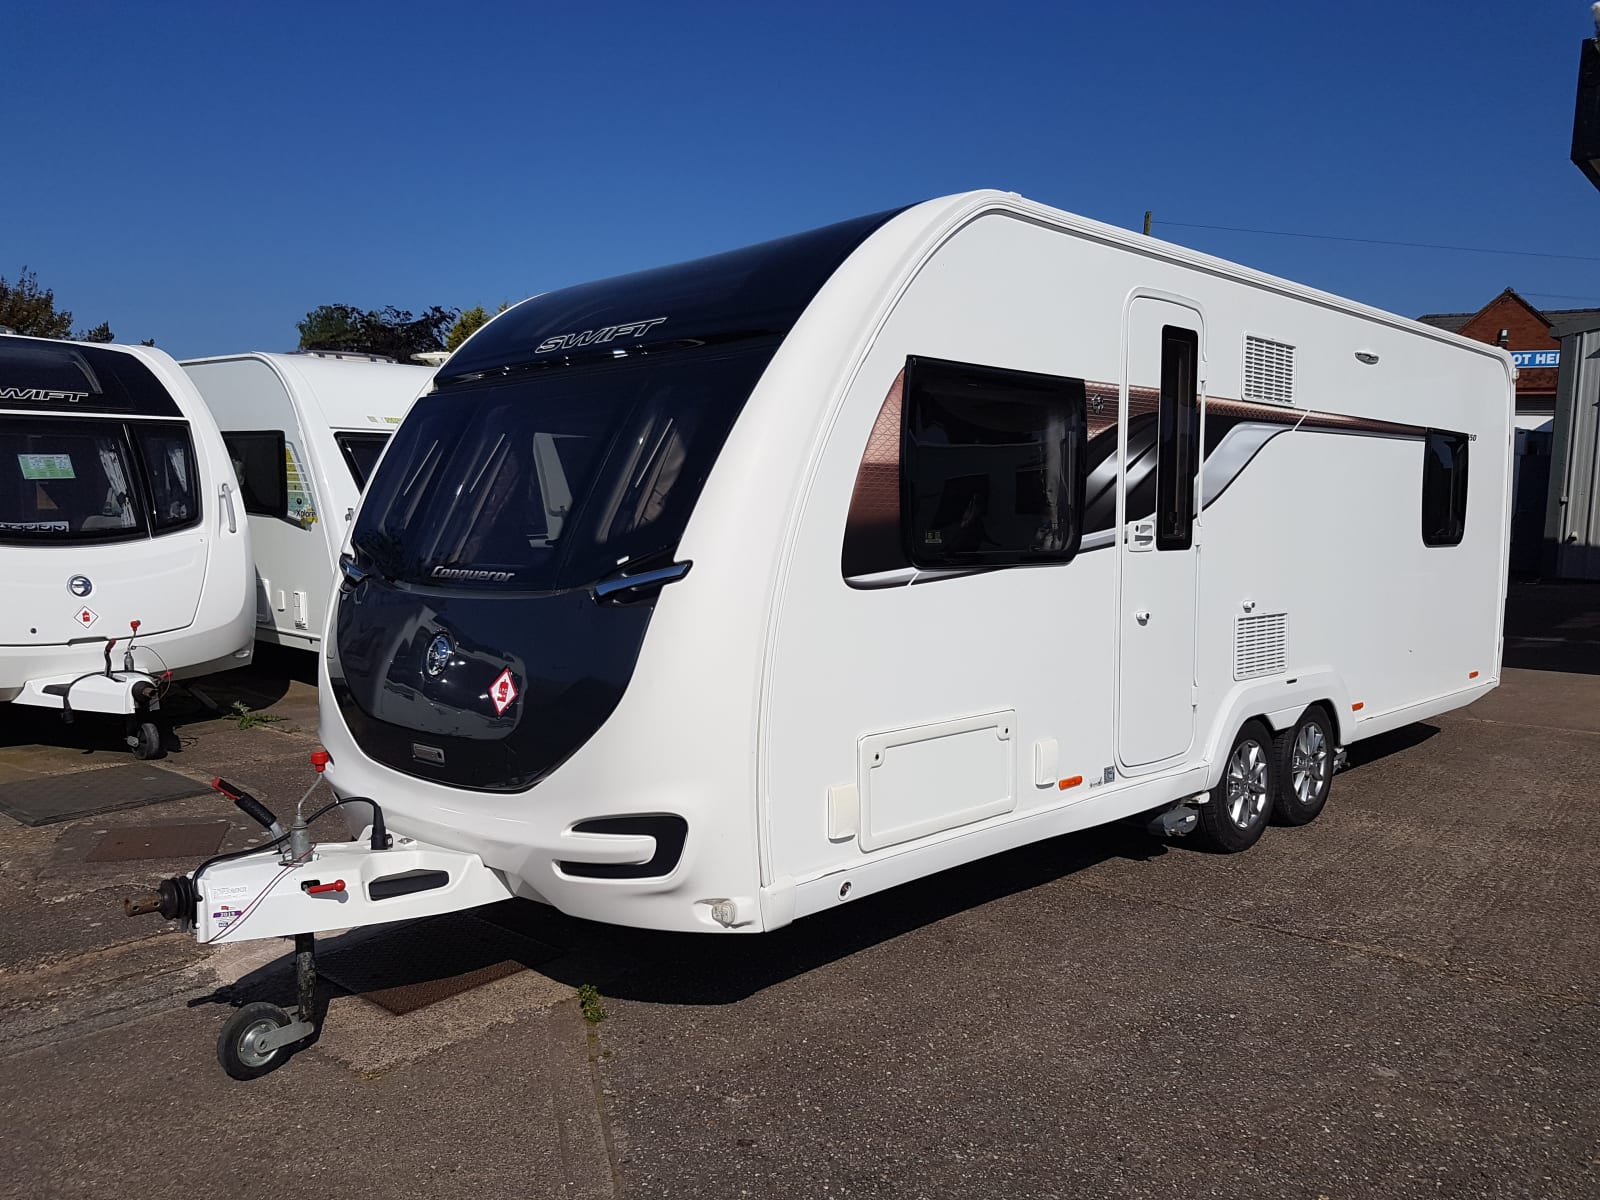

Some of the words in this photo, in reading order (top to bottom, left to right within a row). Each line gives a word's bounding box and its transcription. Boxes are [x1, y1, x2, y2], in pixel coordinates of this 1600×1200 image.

[534, 316, 668, 354] SWIFT
[1512, 353, 1532, 365] OT
[0, 387, 88, 402] WIFT
[431, 565, 515, 582] Conqueror
